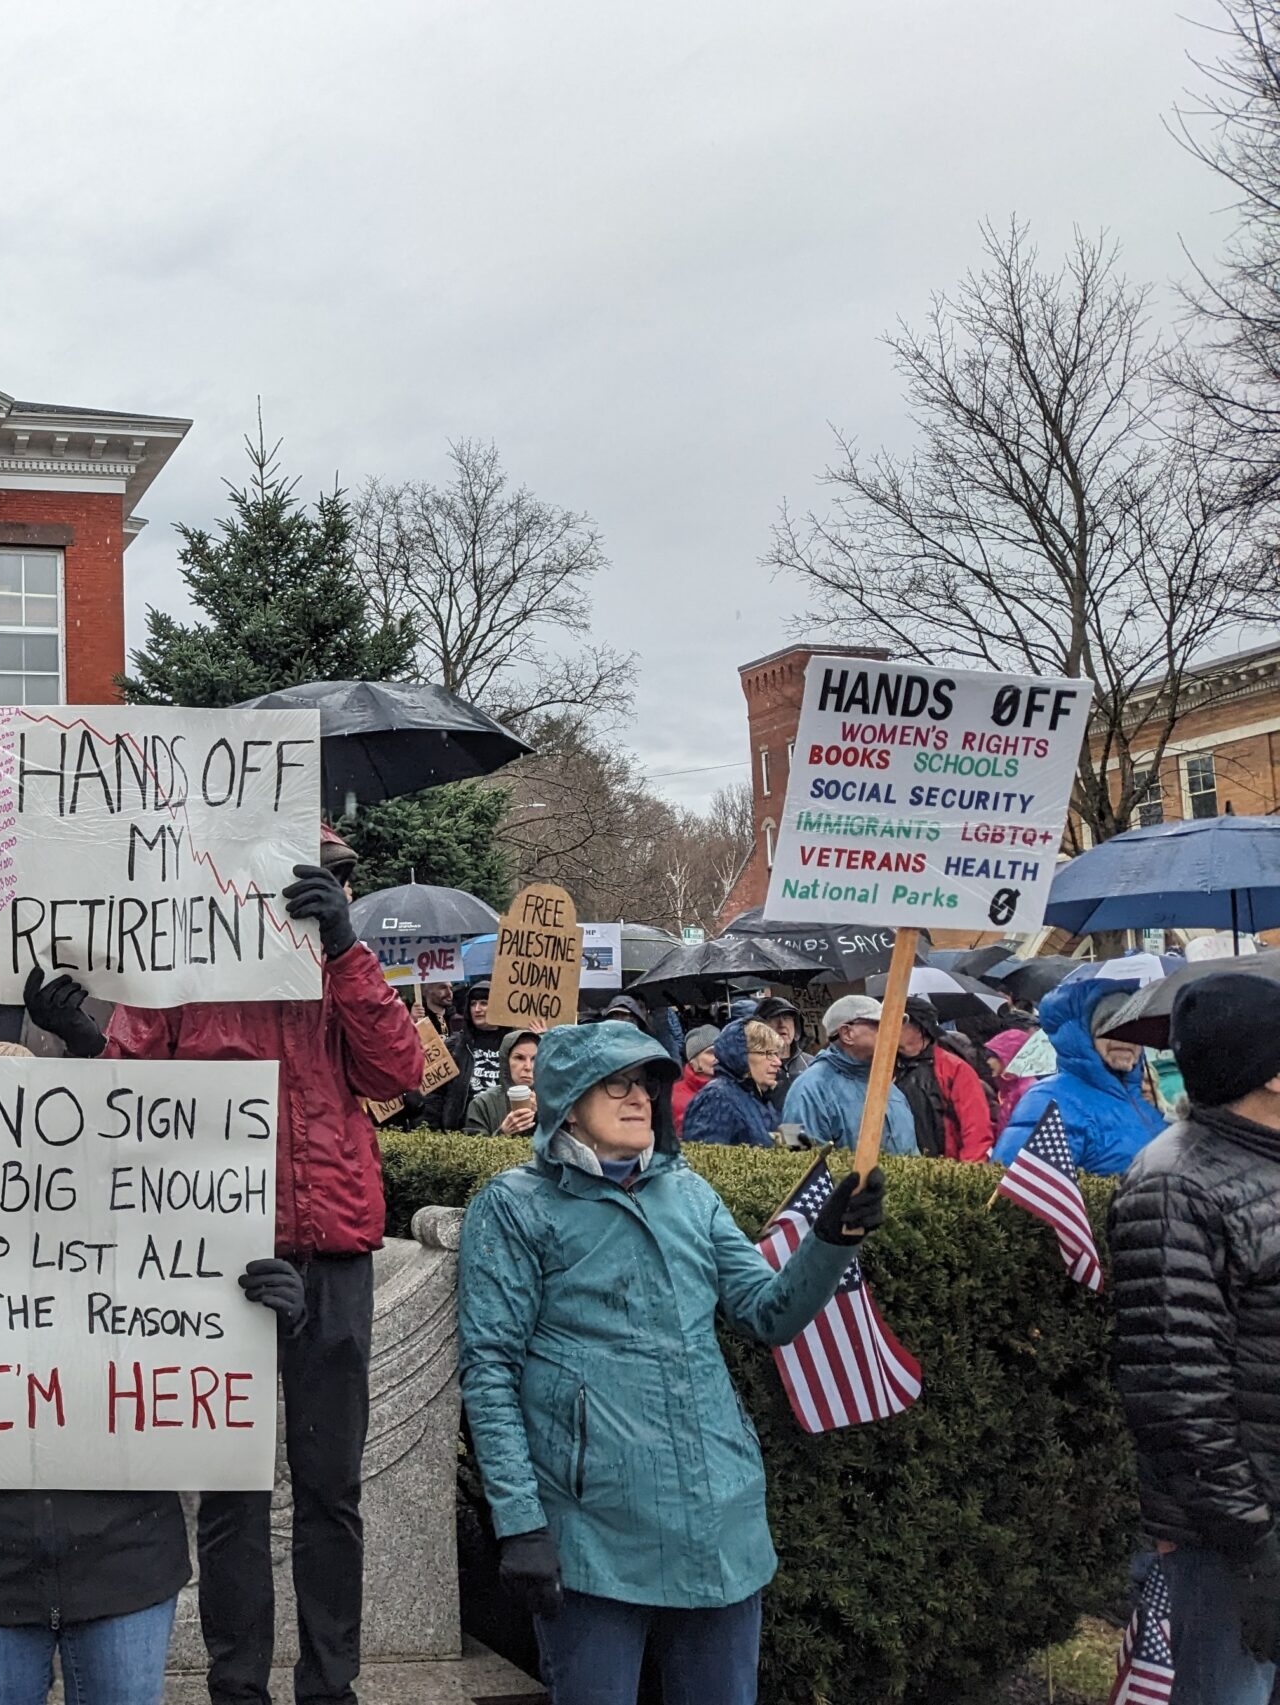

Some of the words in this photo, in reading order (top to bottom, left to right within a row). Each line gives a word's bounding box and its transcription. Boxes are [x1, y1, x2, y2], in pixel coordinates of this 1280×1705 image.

[818, 669, 957, 721] HANDS
[841, 721, 948, 750] WOMEN'S
[961, 732, 1049, 757] RIGHTS
[19, 730, 188, 816] HANDS
[202, 737, 314, 811] OFF
[808, 745, 891, 769] BOOKS
[914, 752, 1019, 777] SCHOOLS
[810, 778, 897, 804] SOCIAL
[909, 786, 1034, 814] SECURITY
[796, 811, 941, 842] IMMIGRANTS
[961, 822, 1053, 846] LGBTQ+
[129, 823, 184, 881] MY
[799, 846, 926, 873] VETERANS
[945, 856, 1039, 881] HEALTH
[523, 894, 564, 928] FREE
[782, 879, 879, 903] National
[892, 885, 958, 908] Parks
[12, 893, 275, 974] RETIREMENT
[499, 929, 576, 963] PALESTINE
[838, 932, 895, 955] SAVE
[509, 961, 561, 990] SUDAN
[508, 990, 561, 1019] CONGO
[421, 1061, 452, 1092] ILENCE
[98, 1088, 196, 1142] SIGN
[225, 1098, 270, 1141] IS
[0, 1161, 76, 1212] BIG
[109, 1166, 266, 1215] ENOUGH
[32, 1232, 118, 1274] LIST
[138, 1234, 223, 1280] ALL
[88, 1293, 224, 1339] REASONS
[109, 1361, 254, 1434] HERE
